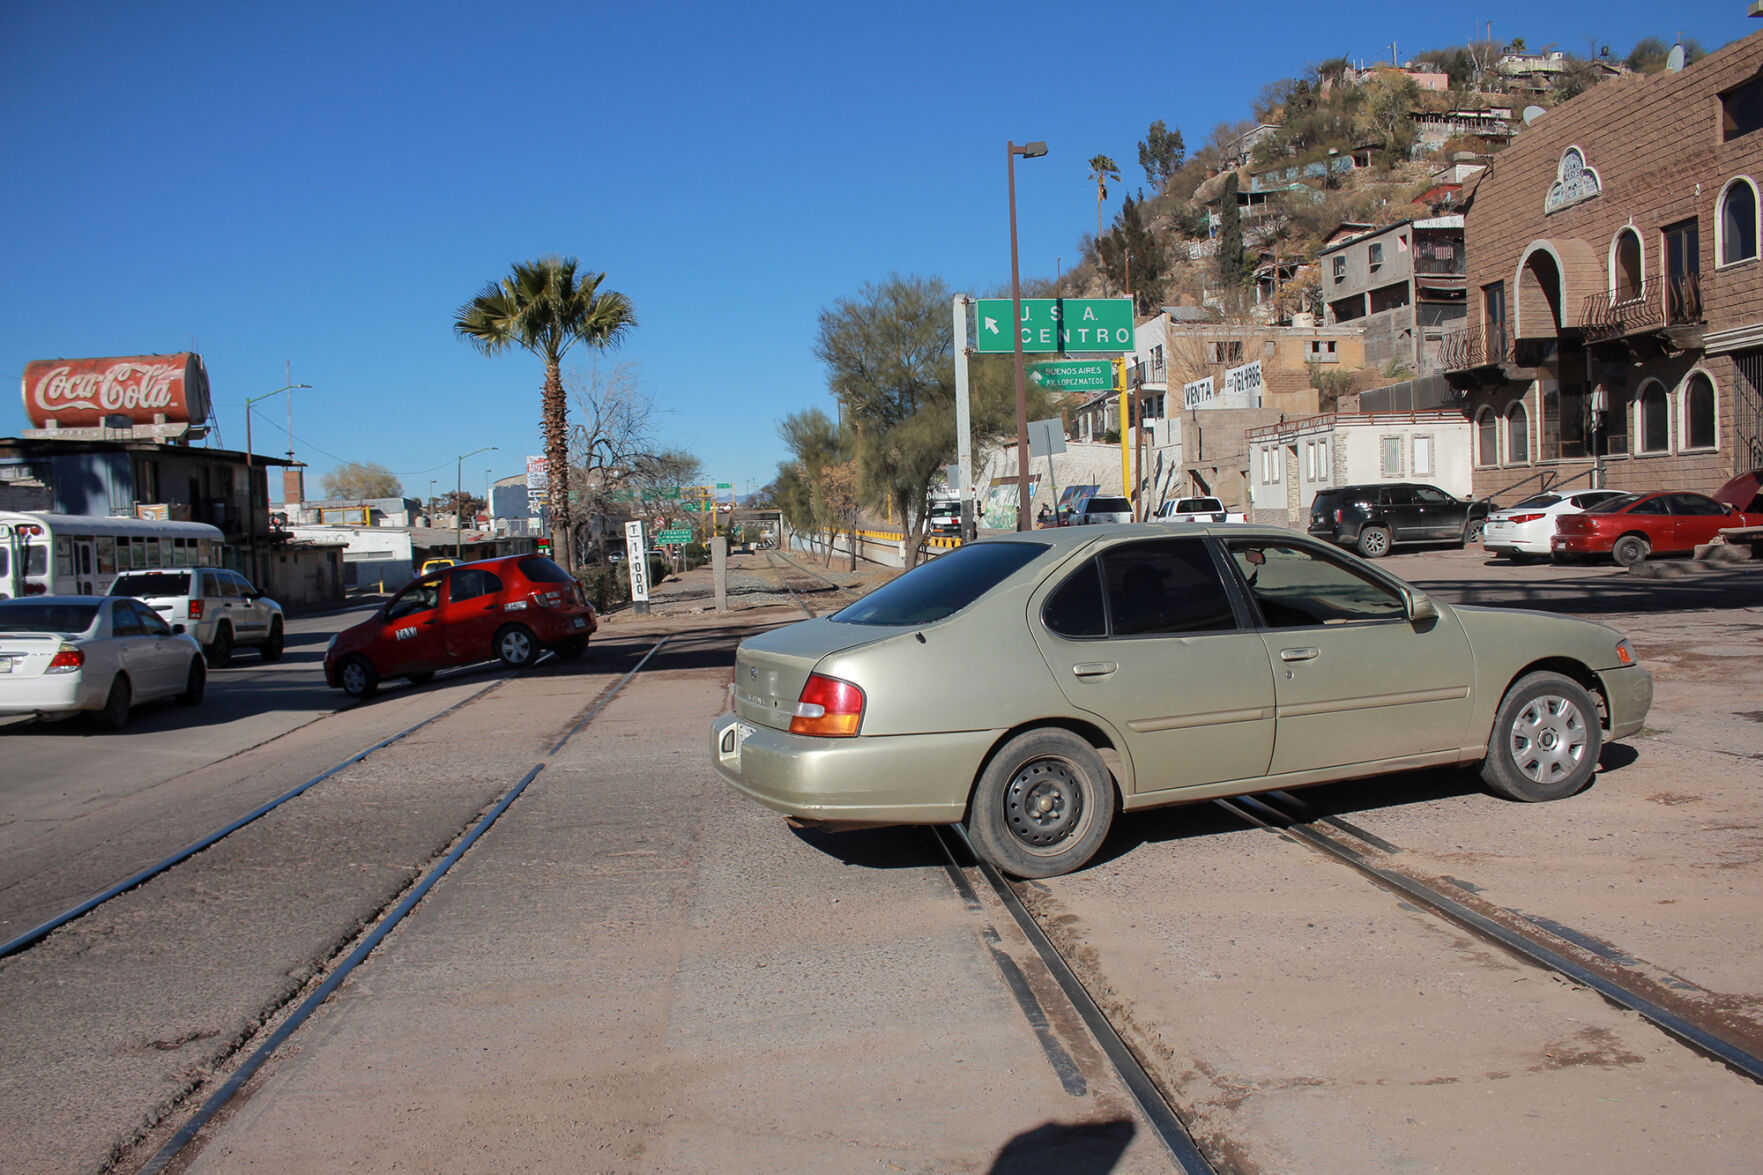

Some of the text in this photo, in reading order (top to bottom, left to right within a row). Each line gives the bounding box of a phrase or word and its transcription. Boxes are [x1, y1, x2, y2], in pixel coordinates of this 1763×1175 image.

[1021, 328, 1129, 343] CENTRO
[1045, 366, 1102, 376] BUENOS AIRES
[35, 363, 181, 411] Coca-Cola
[1057, 378, 1078, 386] LOPEZ
[1078, 377, 1104, 385] MATEOS
[1185, 382, 1212, 405] VENTA
[395, 626, 417, 641] TAXI
